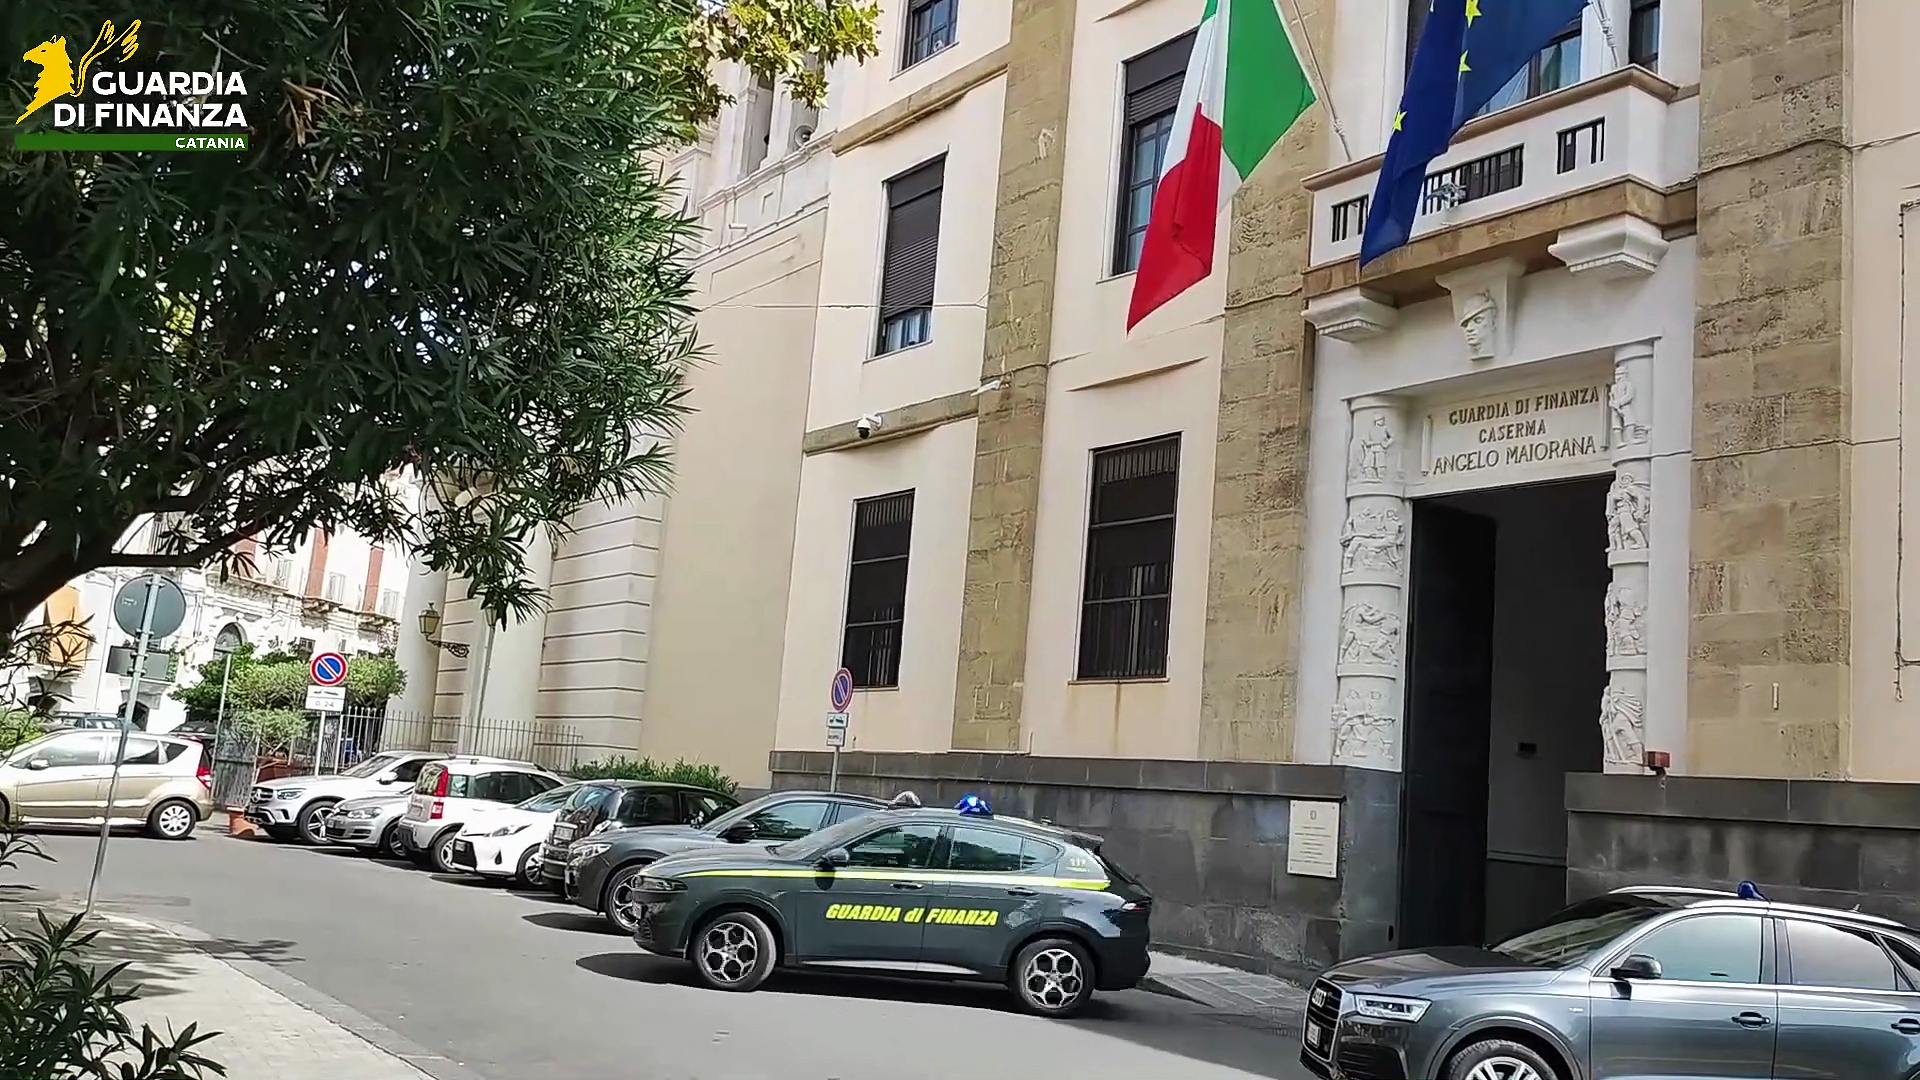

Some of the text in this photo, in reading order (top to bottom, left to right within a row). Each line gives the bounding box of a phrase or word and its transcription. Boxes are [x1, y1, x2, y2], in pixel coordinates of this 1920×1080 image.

[1449, 386, 1600, 426] GUARDIA DI FINANZA
[1479, 419, 1547, 444] CASERMA
[1433, 435, 1597, 476] ANGELO MAIORANA
[825, 903, 901, 922] GUARDIA
[925, 908, 999, 926] FINANZA
